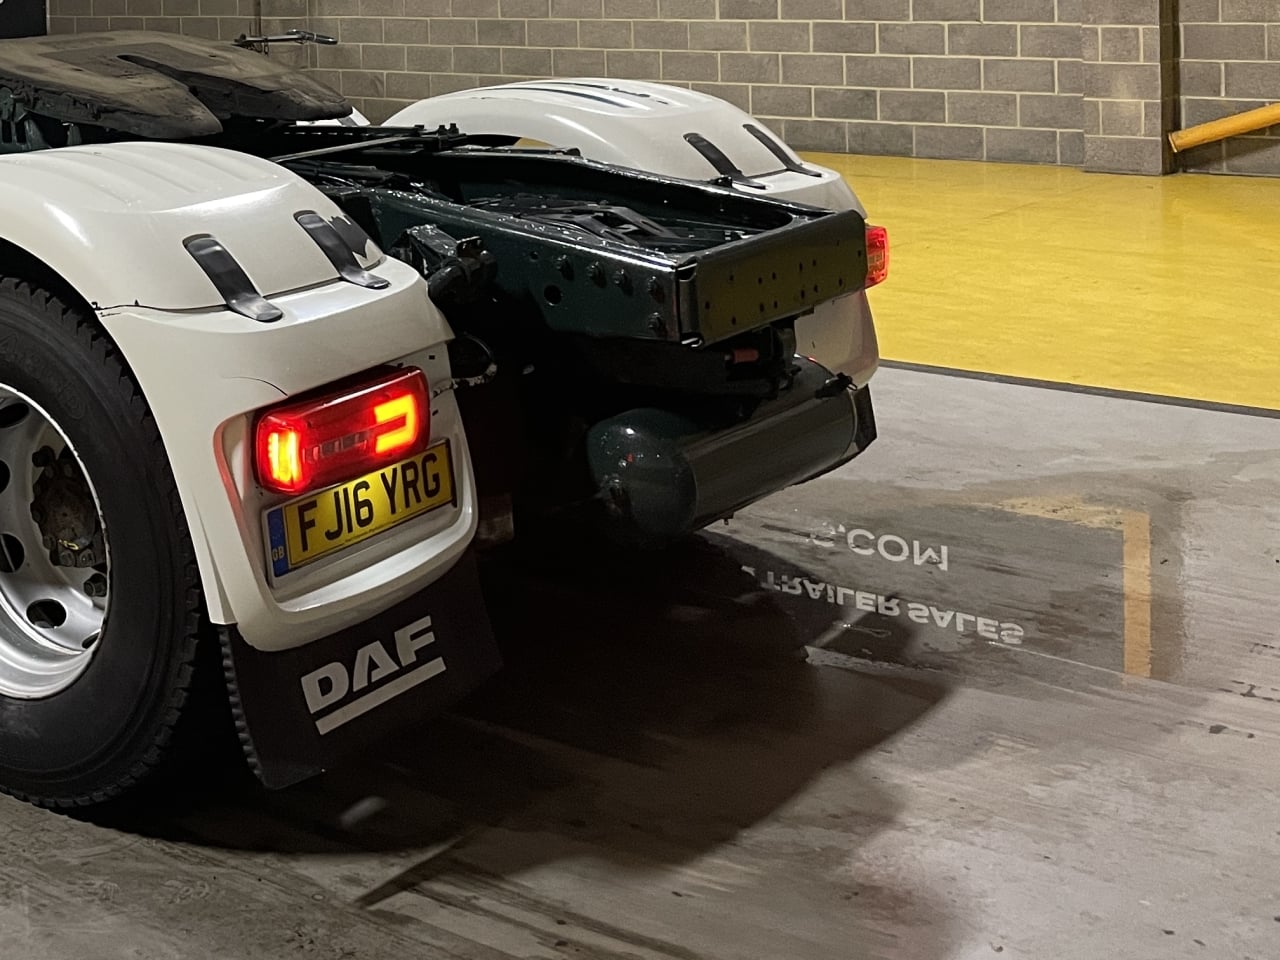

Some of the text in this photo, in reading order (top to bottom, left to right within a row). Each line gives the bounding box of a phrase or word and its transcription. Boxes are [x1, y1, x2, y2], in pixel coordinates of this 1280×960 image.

[298, 452, 441, 552] FJ16 YRG
[301, 615, 436, 715] DAF
